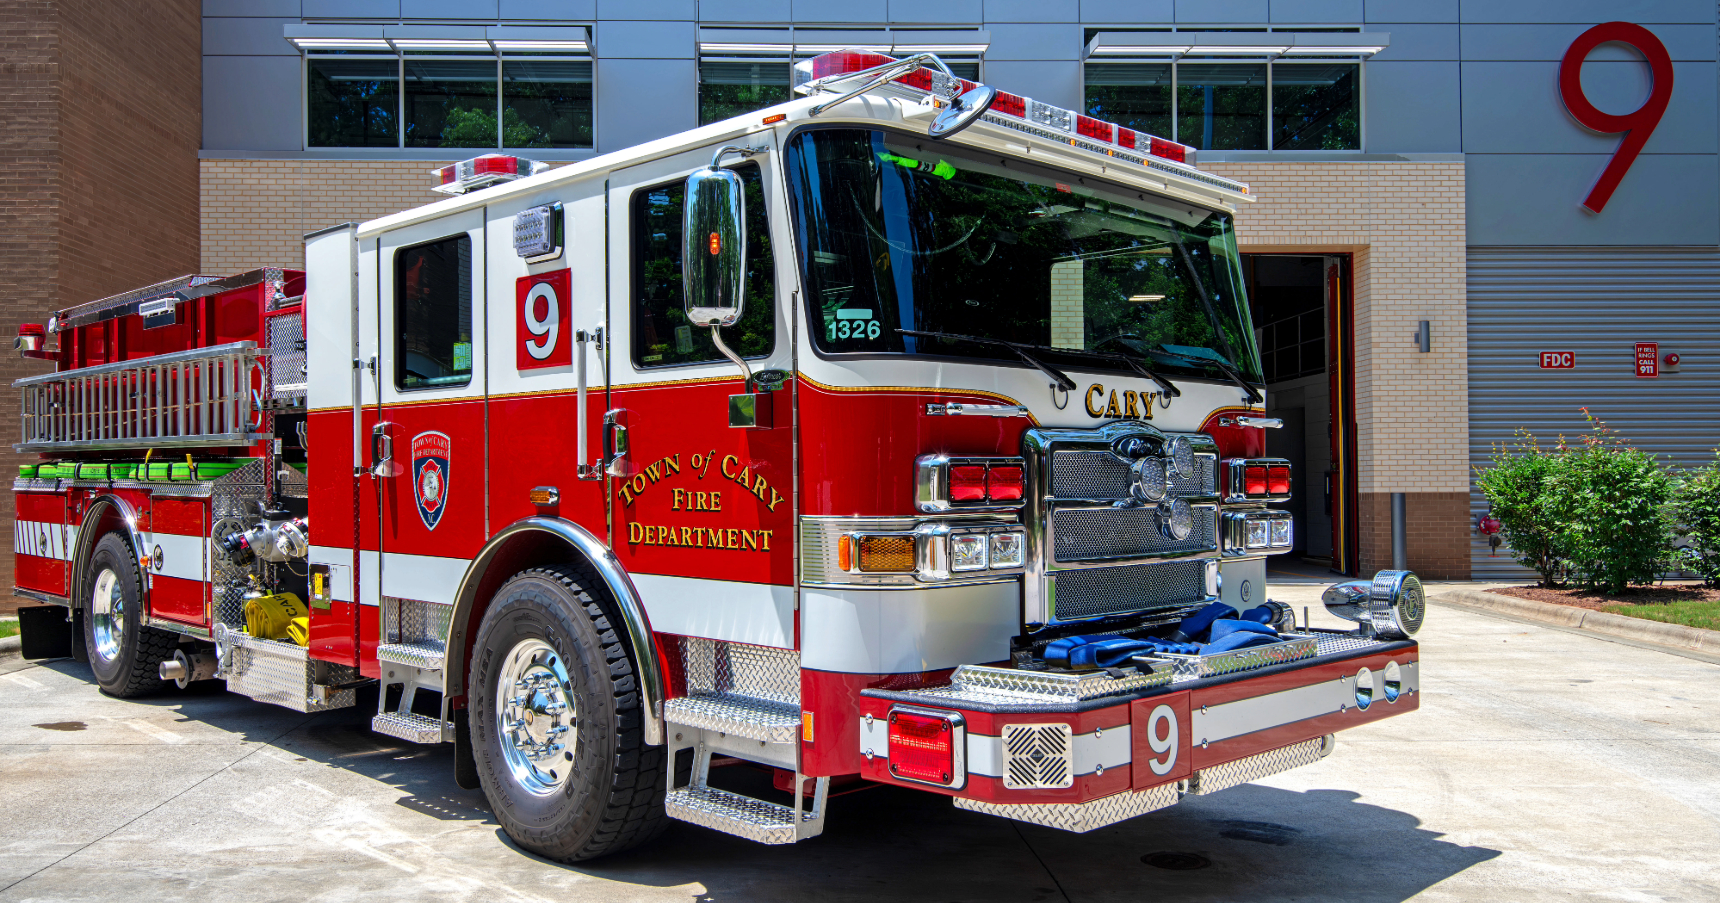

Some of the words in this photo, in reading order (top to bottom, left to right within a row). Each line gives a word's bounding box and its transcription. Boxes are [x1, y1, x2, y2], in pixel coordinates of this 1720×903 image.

[1559, 21, 1674, 214] 9
[525, 283, 559, 359] 9
[828, 320, 881, 339] 1326
[1543, 353, 1571, 367] FDC
[1640, 366, 1654, 374] 911
[1085, 383, 1156, 421] CARY
[414, 436, 429, 450] TOWN
[434, 437, 448, 450] CARY
[618, 453, 680, 508] TOWN
[691, 449, 716, 480] of
[721, 454, 785, 513] CARY
[671, 488, 722, 512] FIRE
[628, 521, 773, 552] DEPARTMENT
[544, 624, 585, 800] GOODYEAR
[1147, 704, 1179, 776] 9
